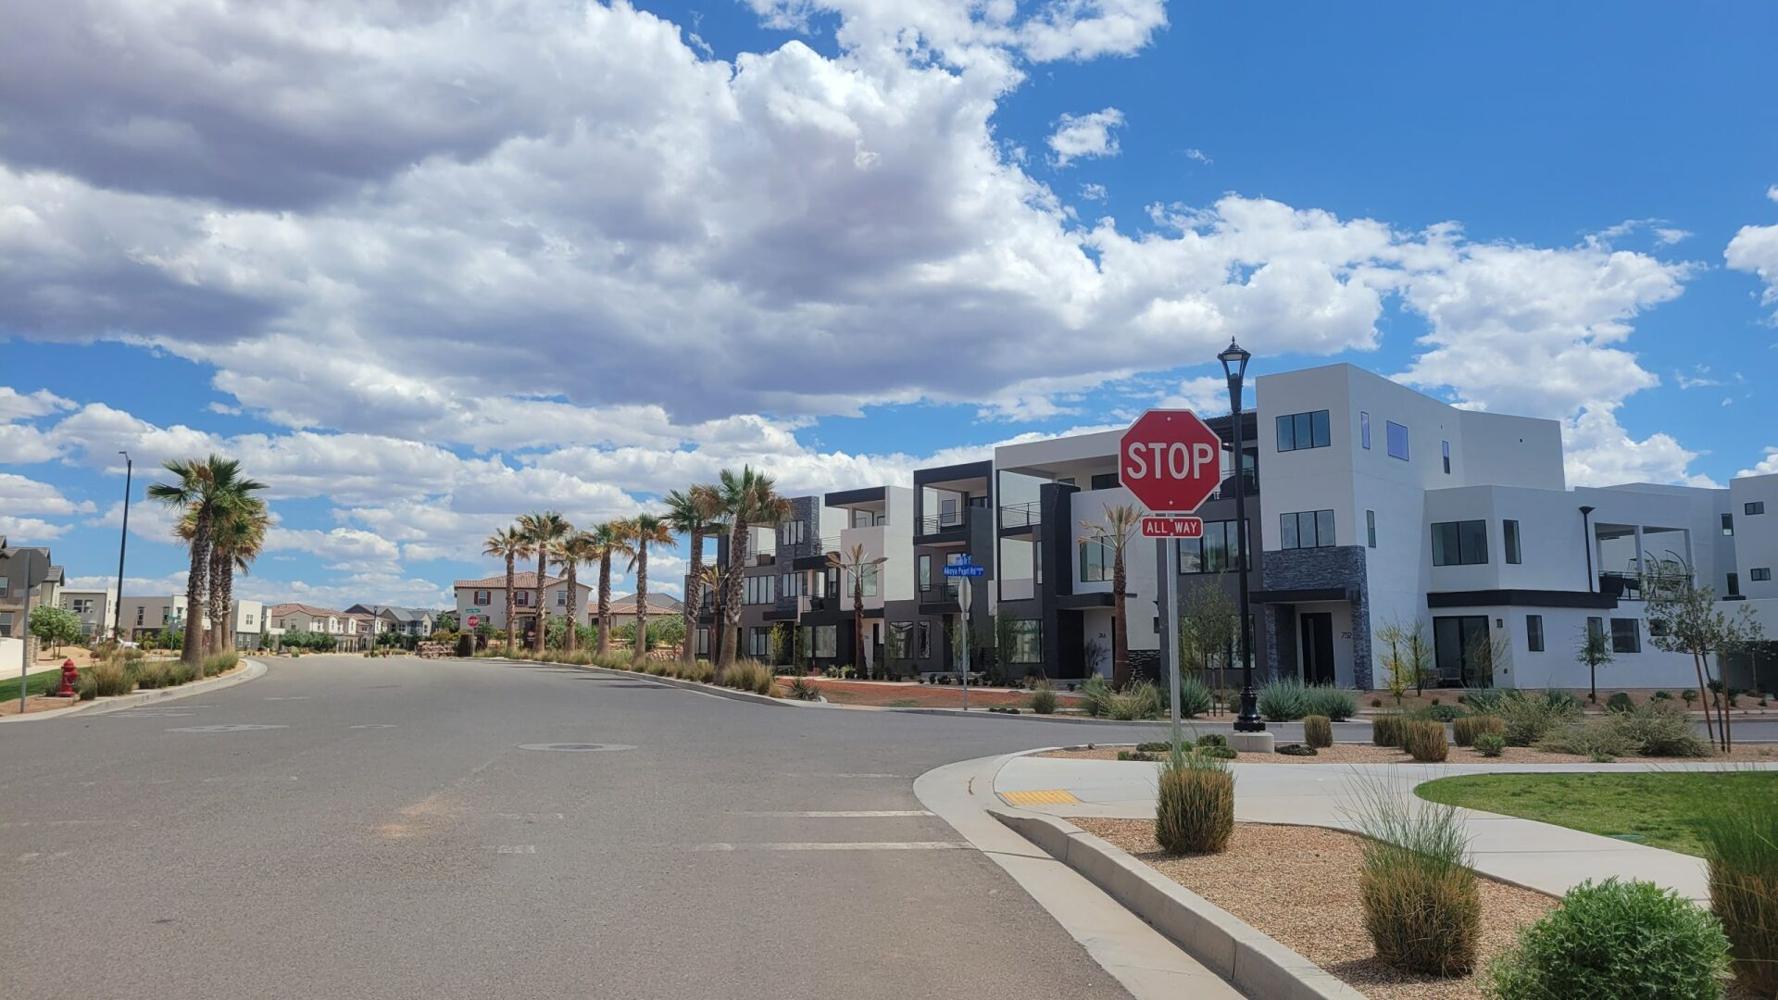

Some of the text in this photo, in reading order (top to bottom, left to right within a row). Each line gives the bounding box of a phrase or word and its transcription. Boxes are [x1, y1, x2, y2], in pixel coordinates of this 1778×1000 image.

[1127, 441, 1214, 480] STOP
[1146, 522, 1198, 534] ALL WAY
